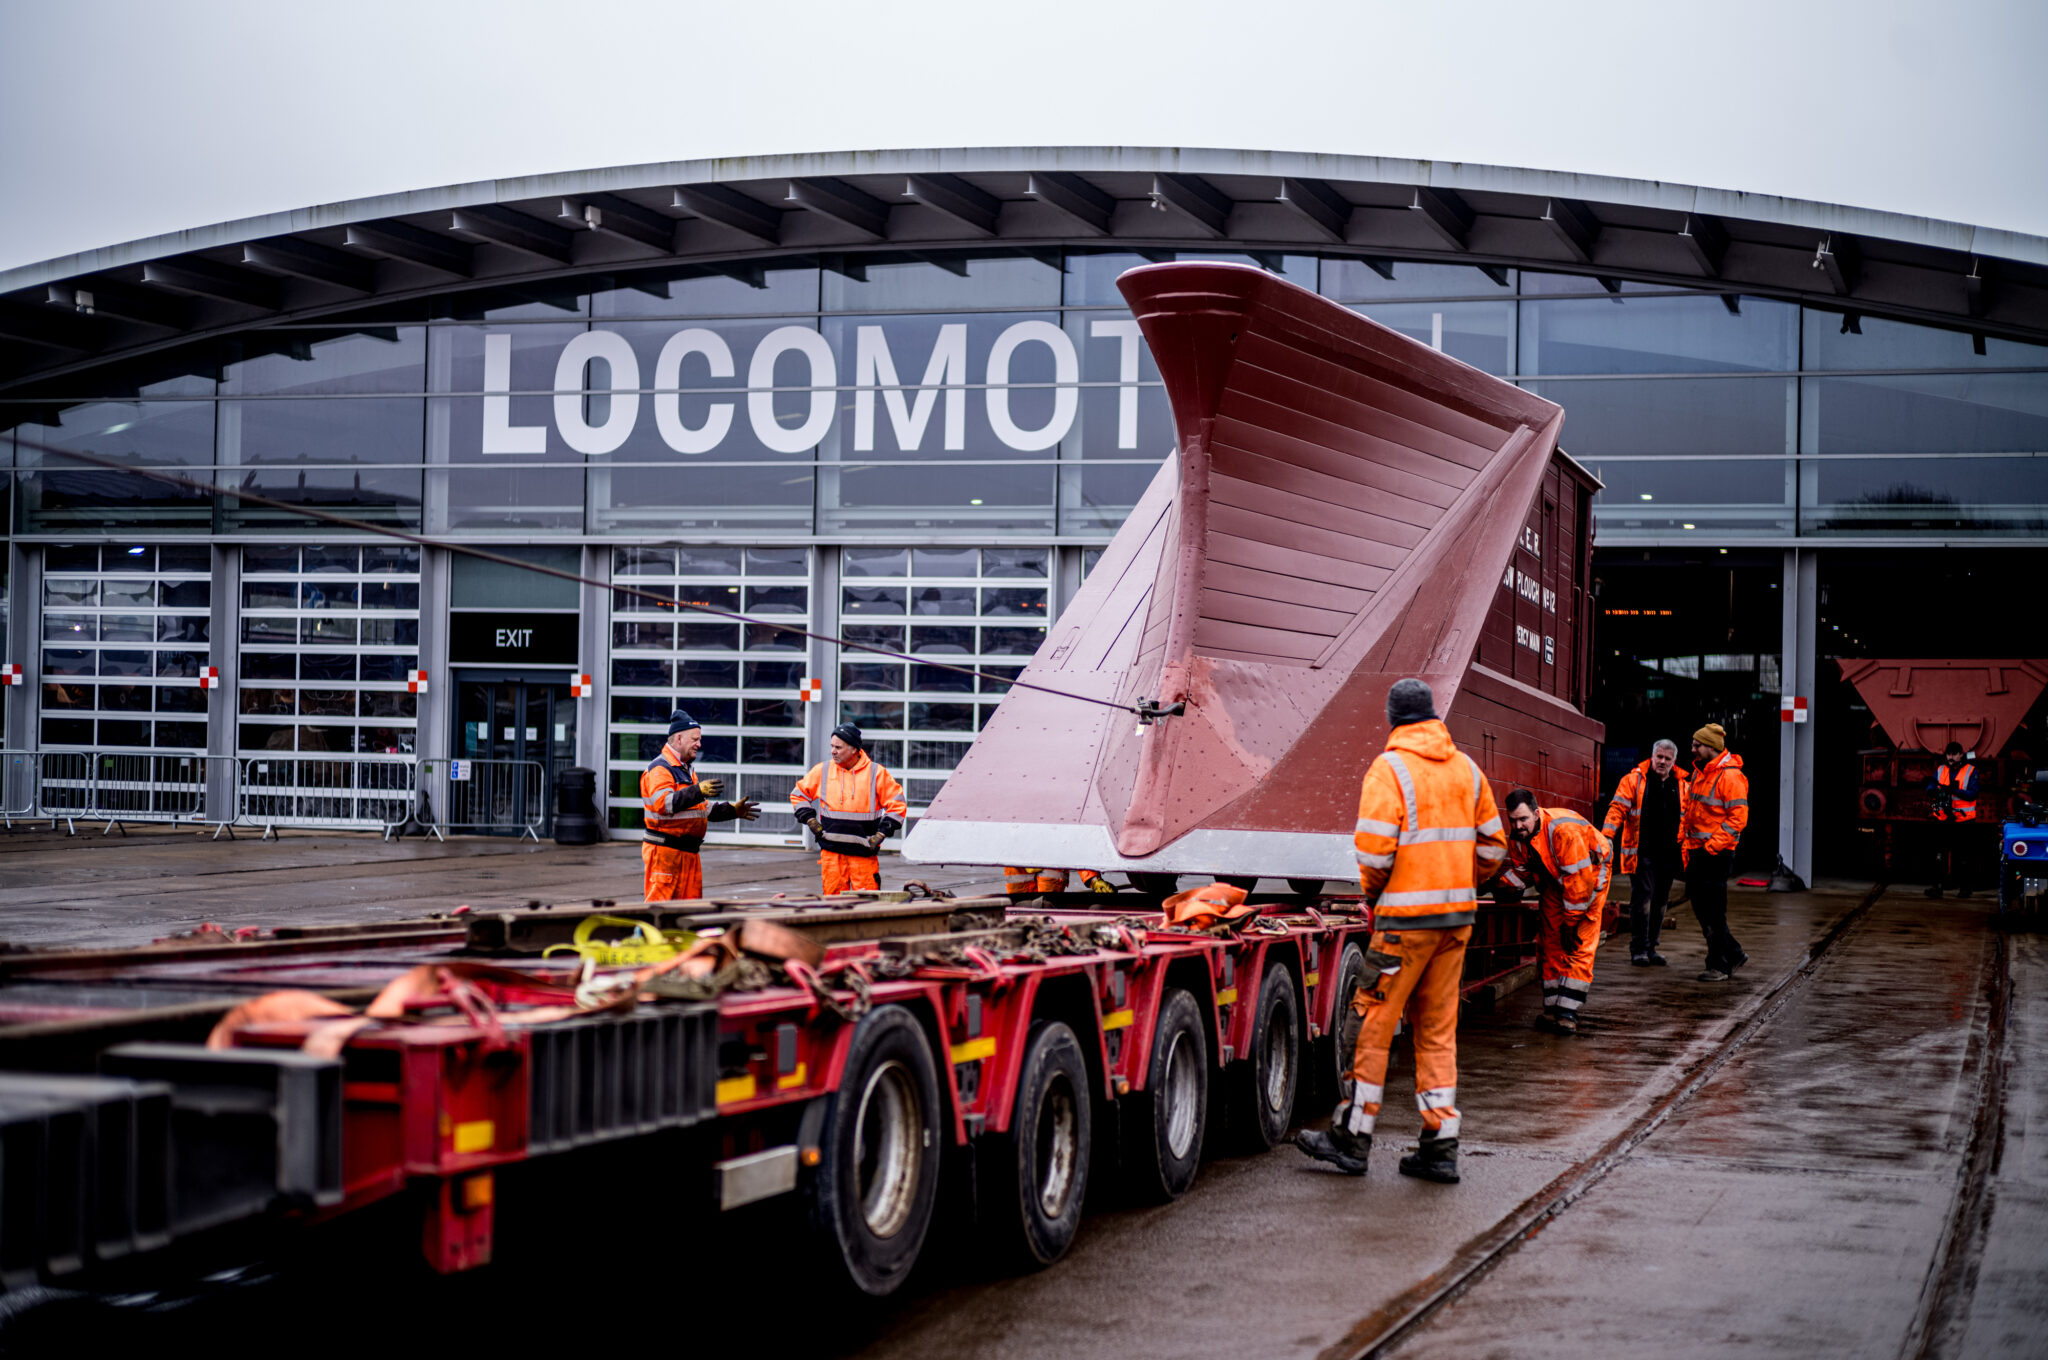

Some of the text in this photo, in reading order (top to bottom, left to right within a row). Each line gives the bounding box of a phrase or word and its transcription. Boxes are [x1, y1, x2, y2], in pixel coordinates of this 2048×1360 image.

[482, 313, 1443, 454] LOCOMOT
[1517, 570, 1540, 605] PLOUGH
[496, 628, 533, 648] EXIT
